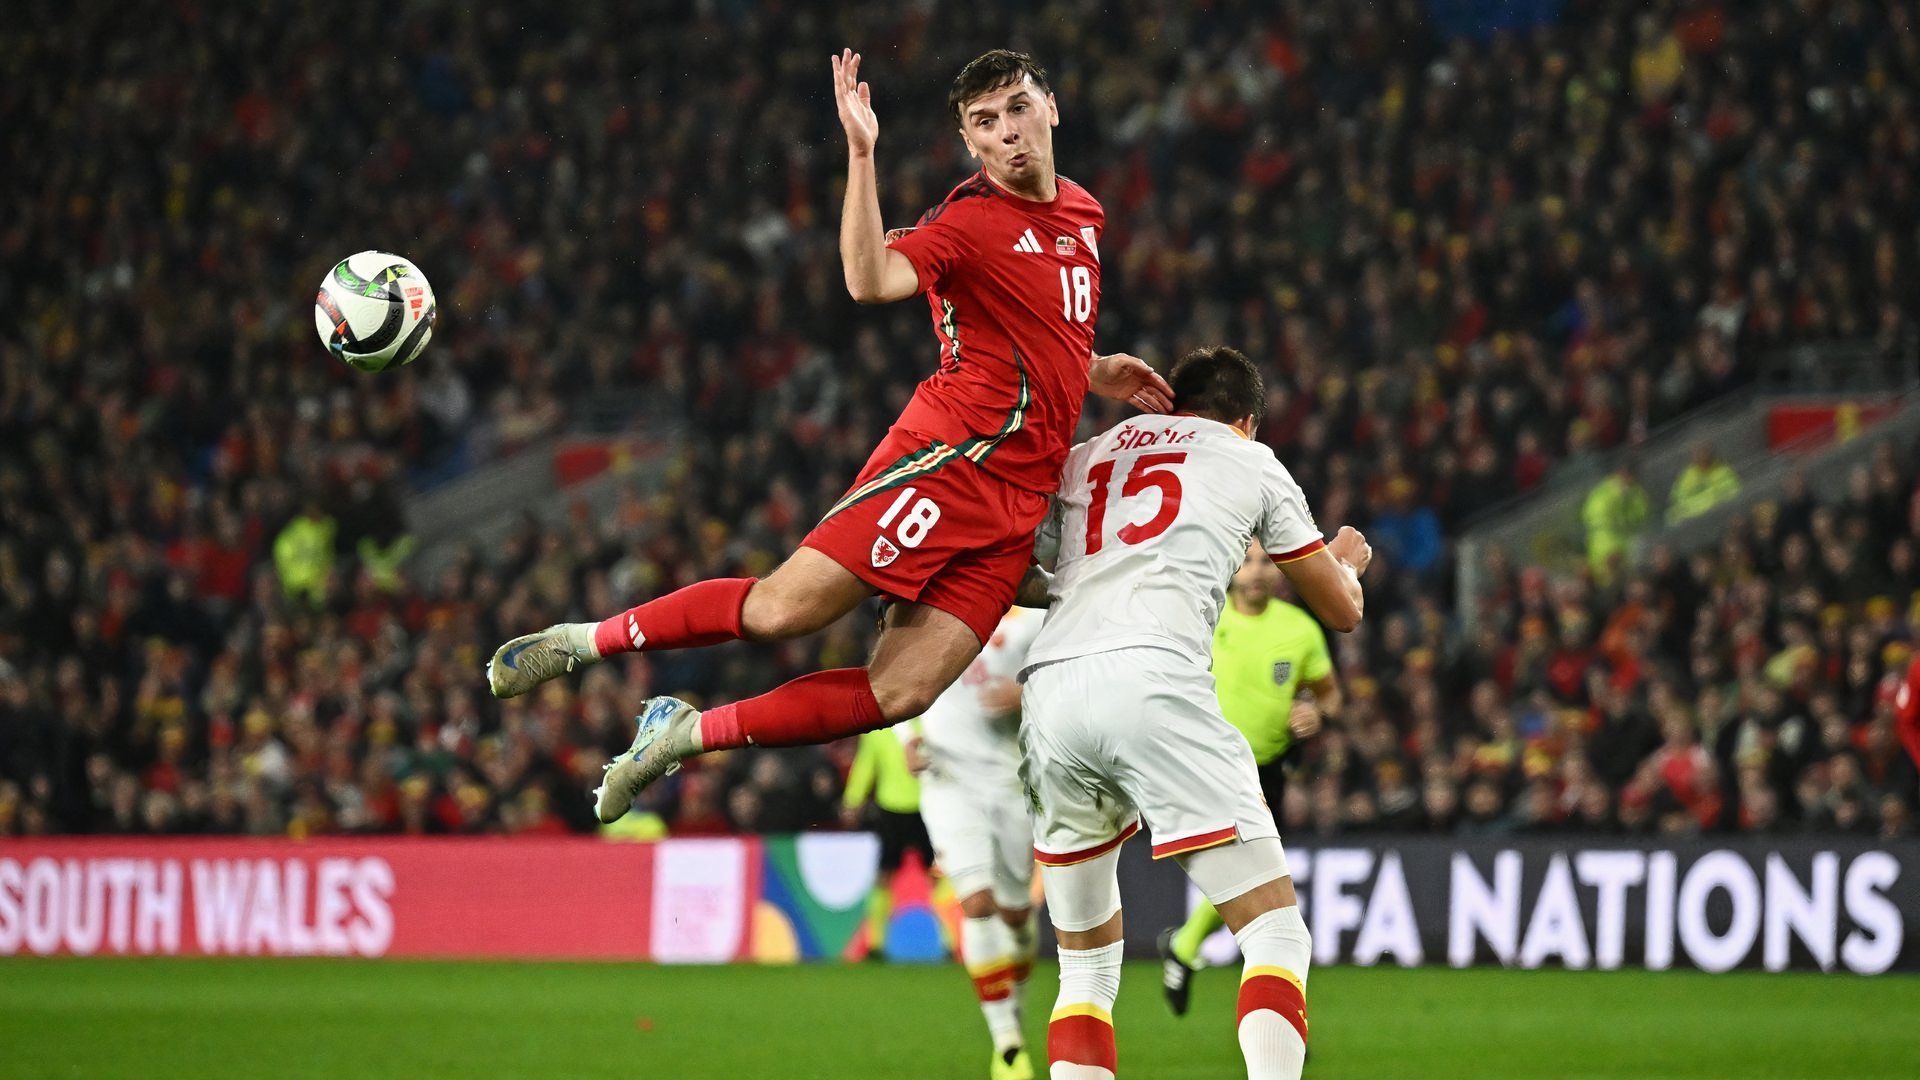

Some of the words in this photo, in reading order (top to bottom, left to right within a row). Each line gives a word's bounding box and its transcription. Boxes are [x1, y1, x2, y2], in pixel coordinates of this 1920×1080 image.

[1059, 266, 1092, 323] 18
[877, 487, 941, 548] 18
[1085, 452, 1188, 556] 15
[0, 857, 183, 955] SOUTH
[190, 857, 396, 957] WALES
[1449, 849, 1903, 975] NATIONS
